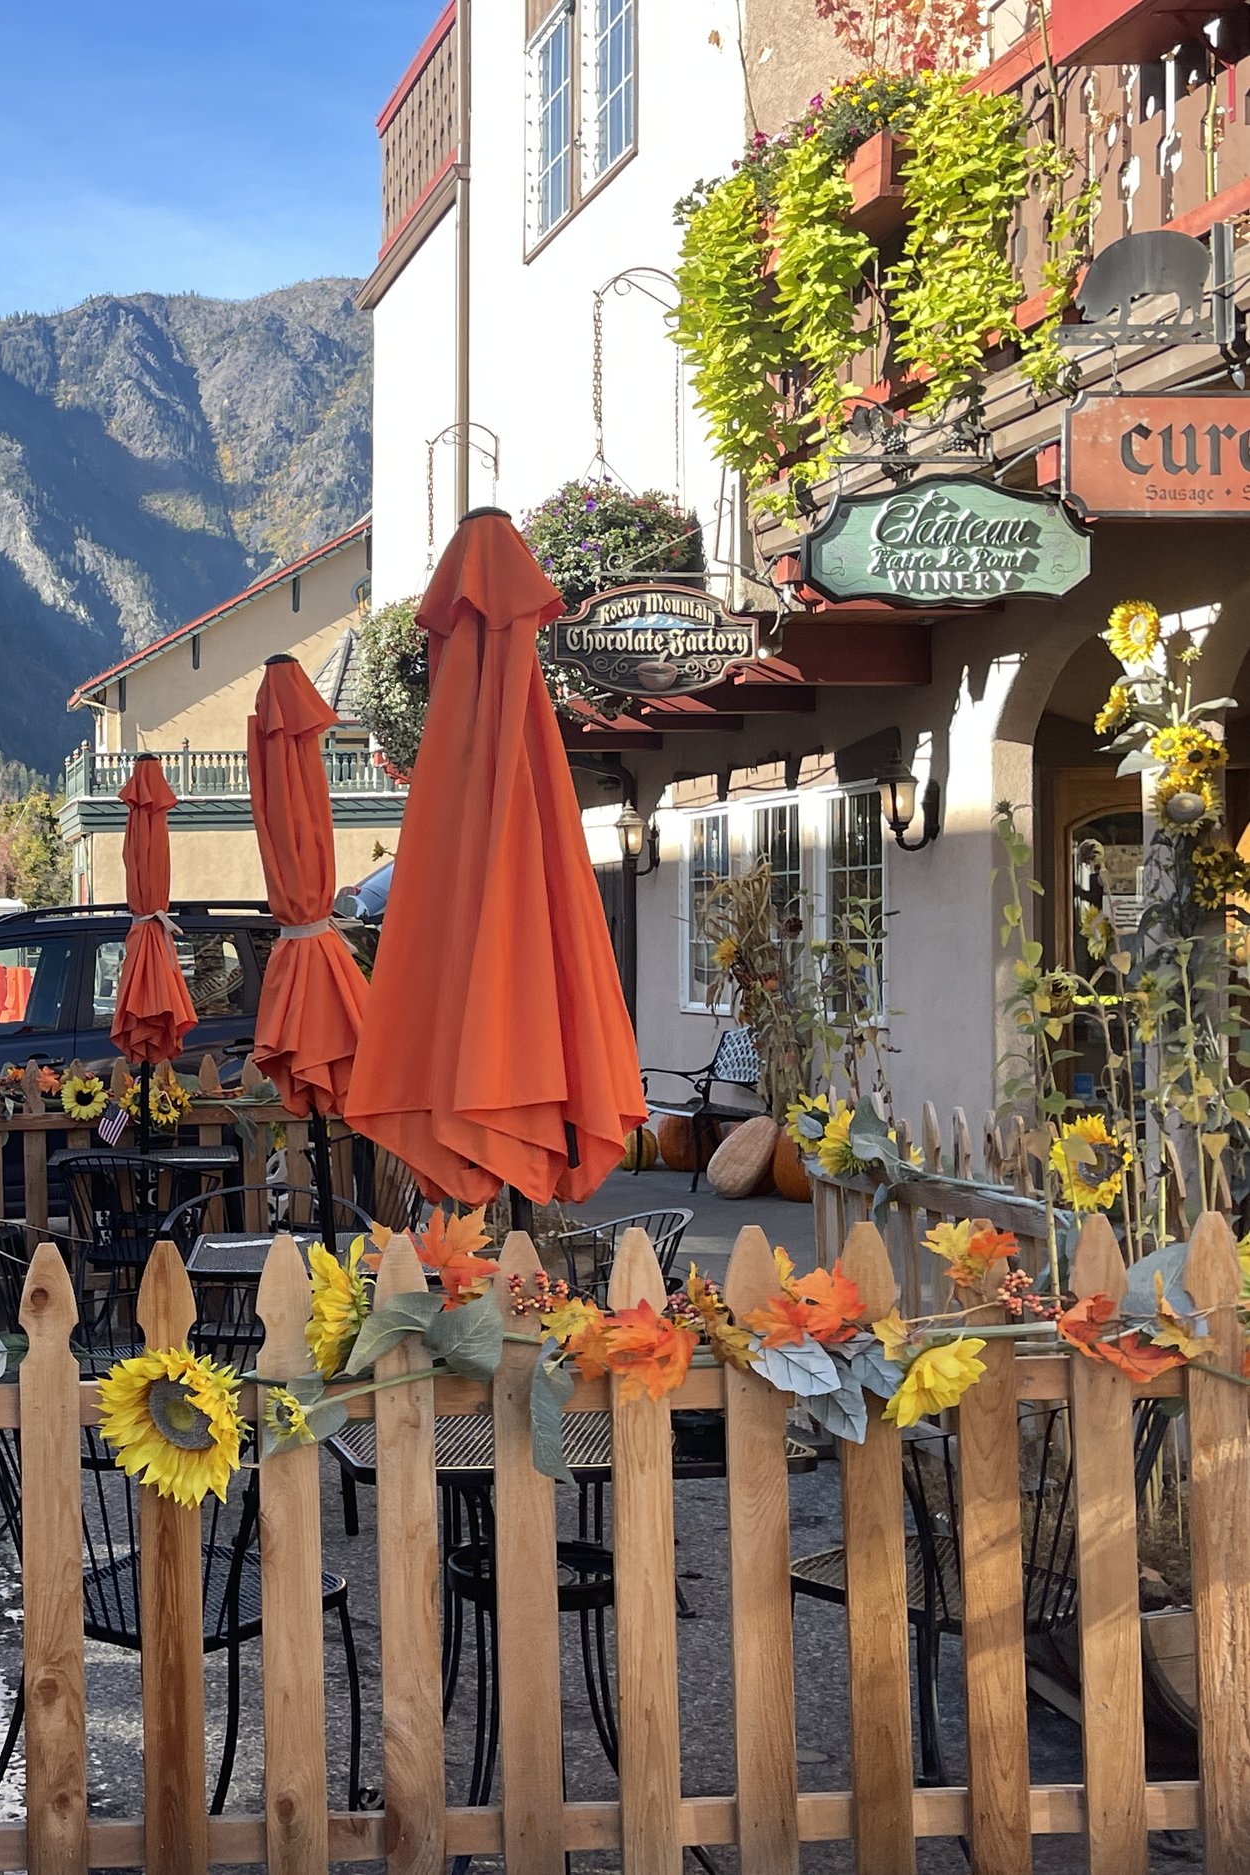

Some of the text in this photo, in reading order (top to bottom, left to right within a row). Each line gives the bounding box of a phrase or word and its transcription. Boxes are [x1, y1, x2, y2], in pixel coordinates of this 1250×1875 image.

[1146, 484, 1214, 505] Sausage
[871, 489, 1030, 545] Château
[867, 543, 1027, 574] Faire Le Pont
[887, 570, 1013, 590] WINERY
[600, 593, 716, 625] Rocky Mountain
[566, 627, 749, 657] Chocolate Factory
